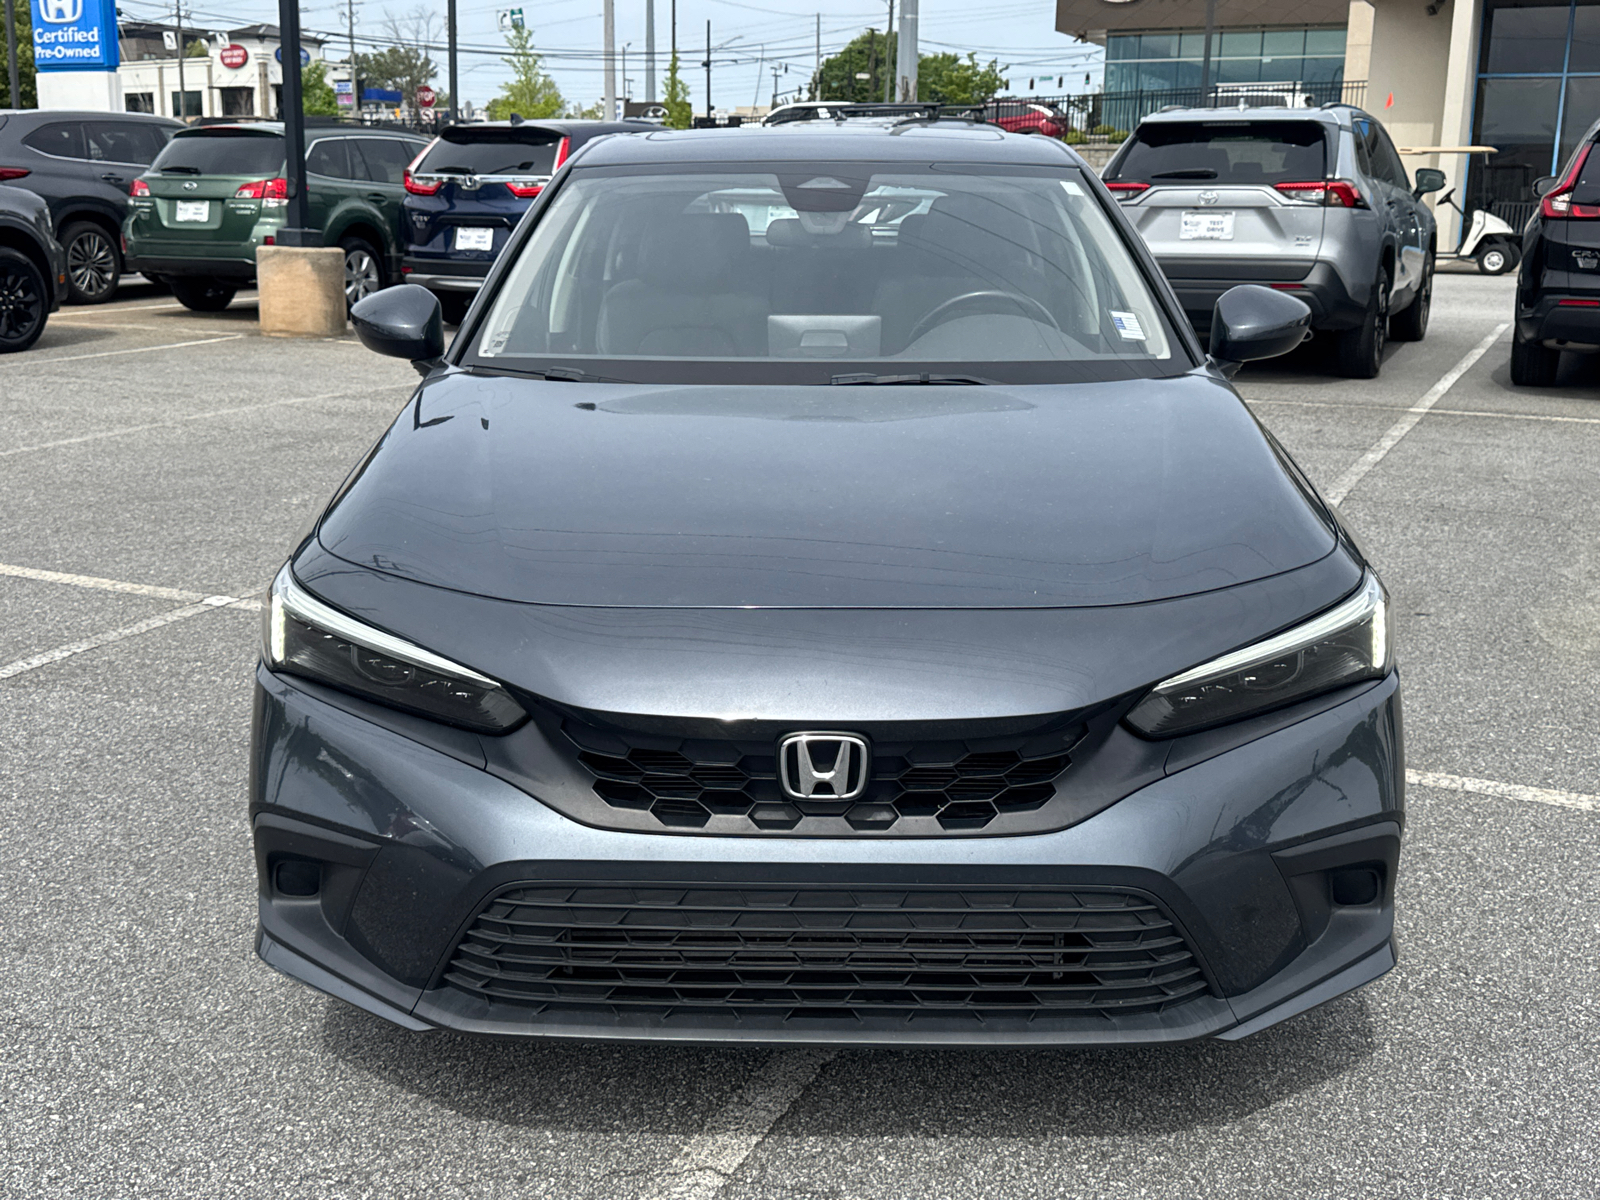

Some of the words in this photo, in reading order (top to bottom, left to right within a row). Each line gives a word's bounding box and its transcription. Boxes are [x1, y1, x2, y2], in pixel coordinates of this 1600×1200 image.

[34, 26, 99, 44] Certified
[35, 44, 100, 59] Pre-Owned
[416, 91, 435, 102] STOP
